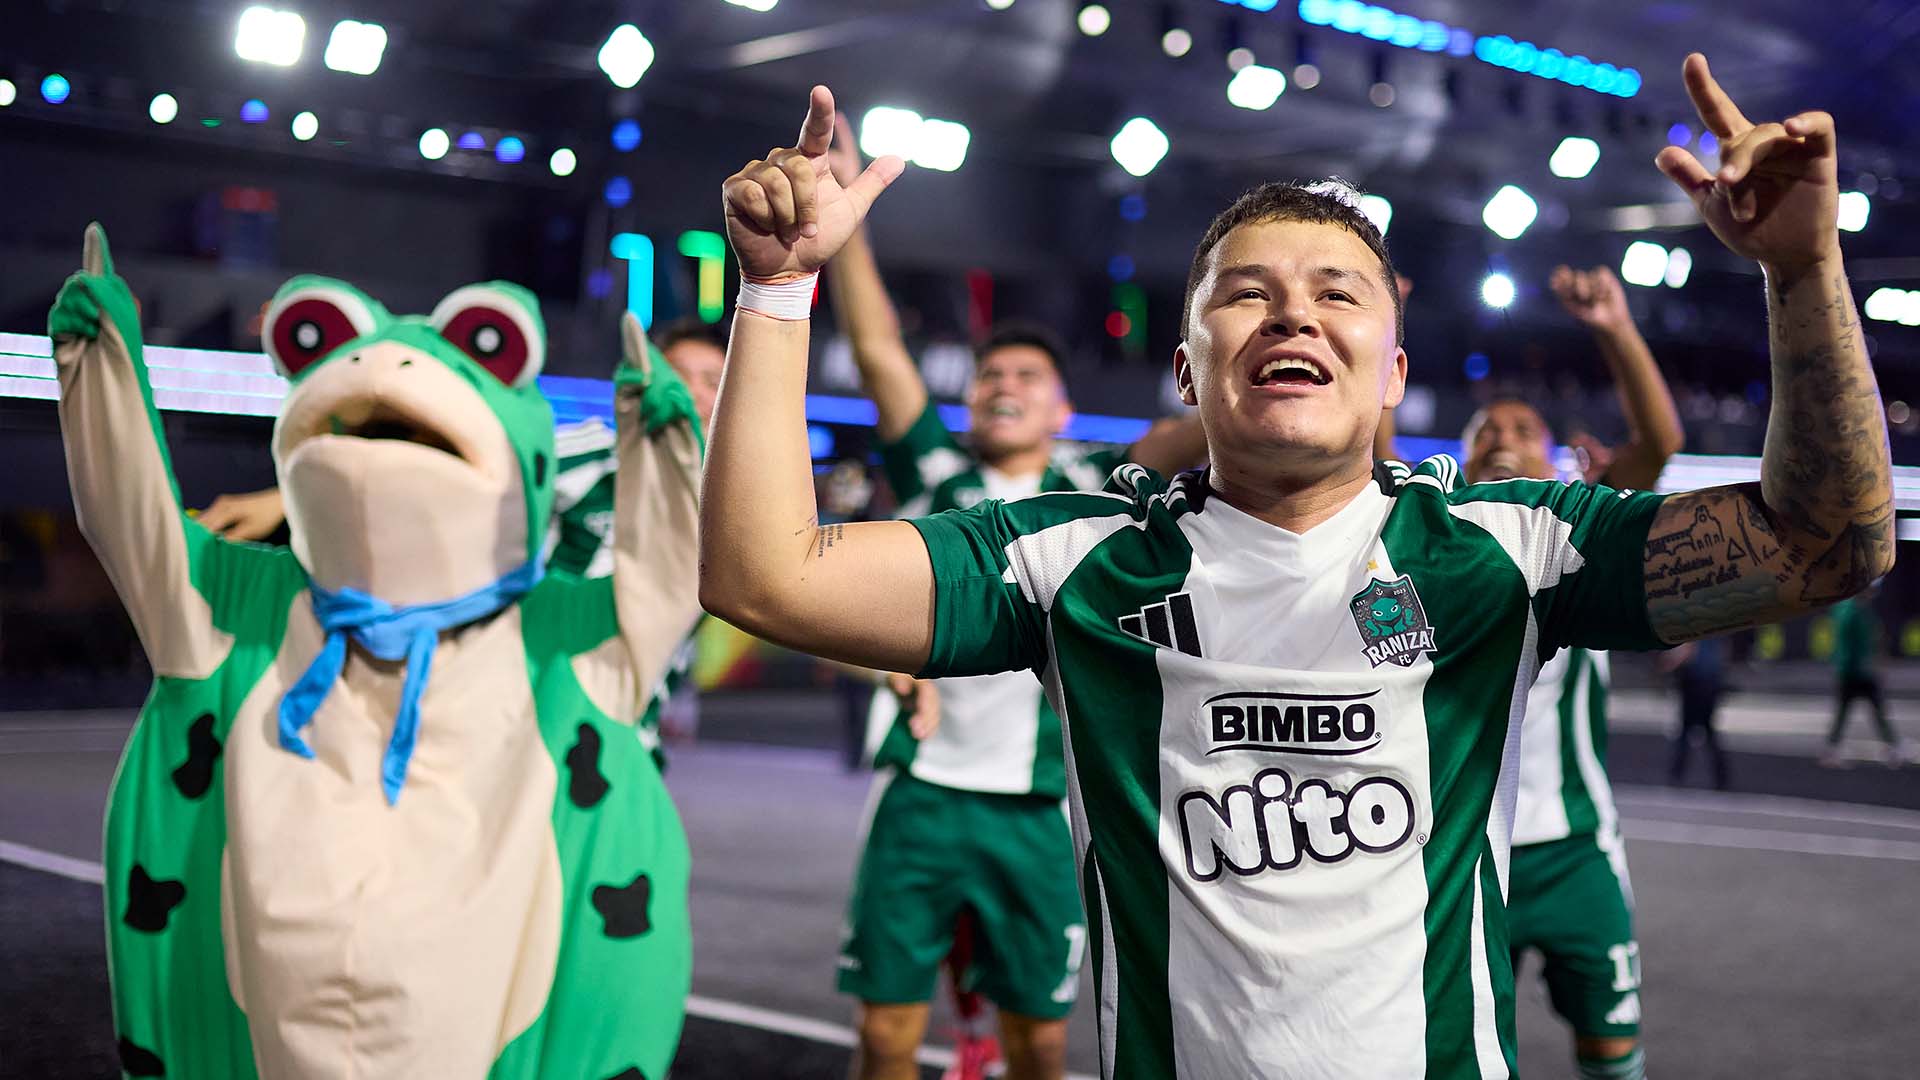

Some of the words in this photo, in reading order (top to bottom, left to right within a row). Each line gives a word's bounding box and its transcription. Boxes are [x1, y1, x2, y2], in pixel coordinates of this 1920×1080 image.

[1366, 630, 1431, 665] RANIZA
[1398, 653, 1412, 666] FC
[1211, 703, 1376, 743] BIMBO
[1177, 767, 1416, 882] Nito
